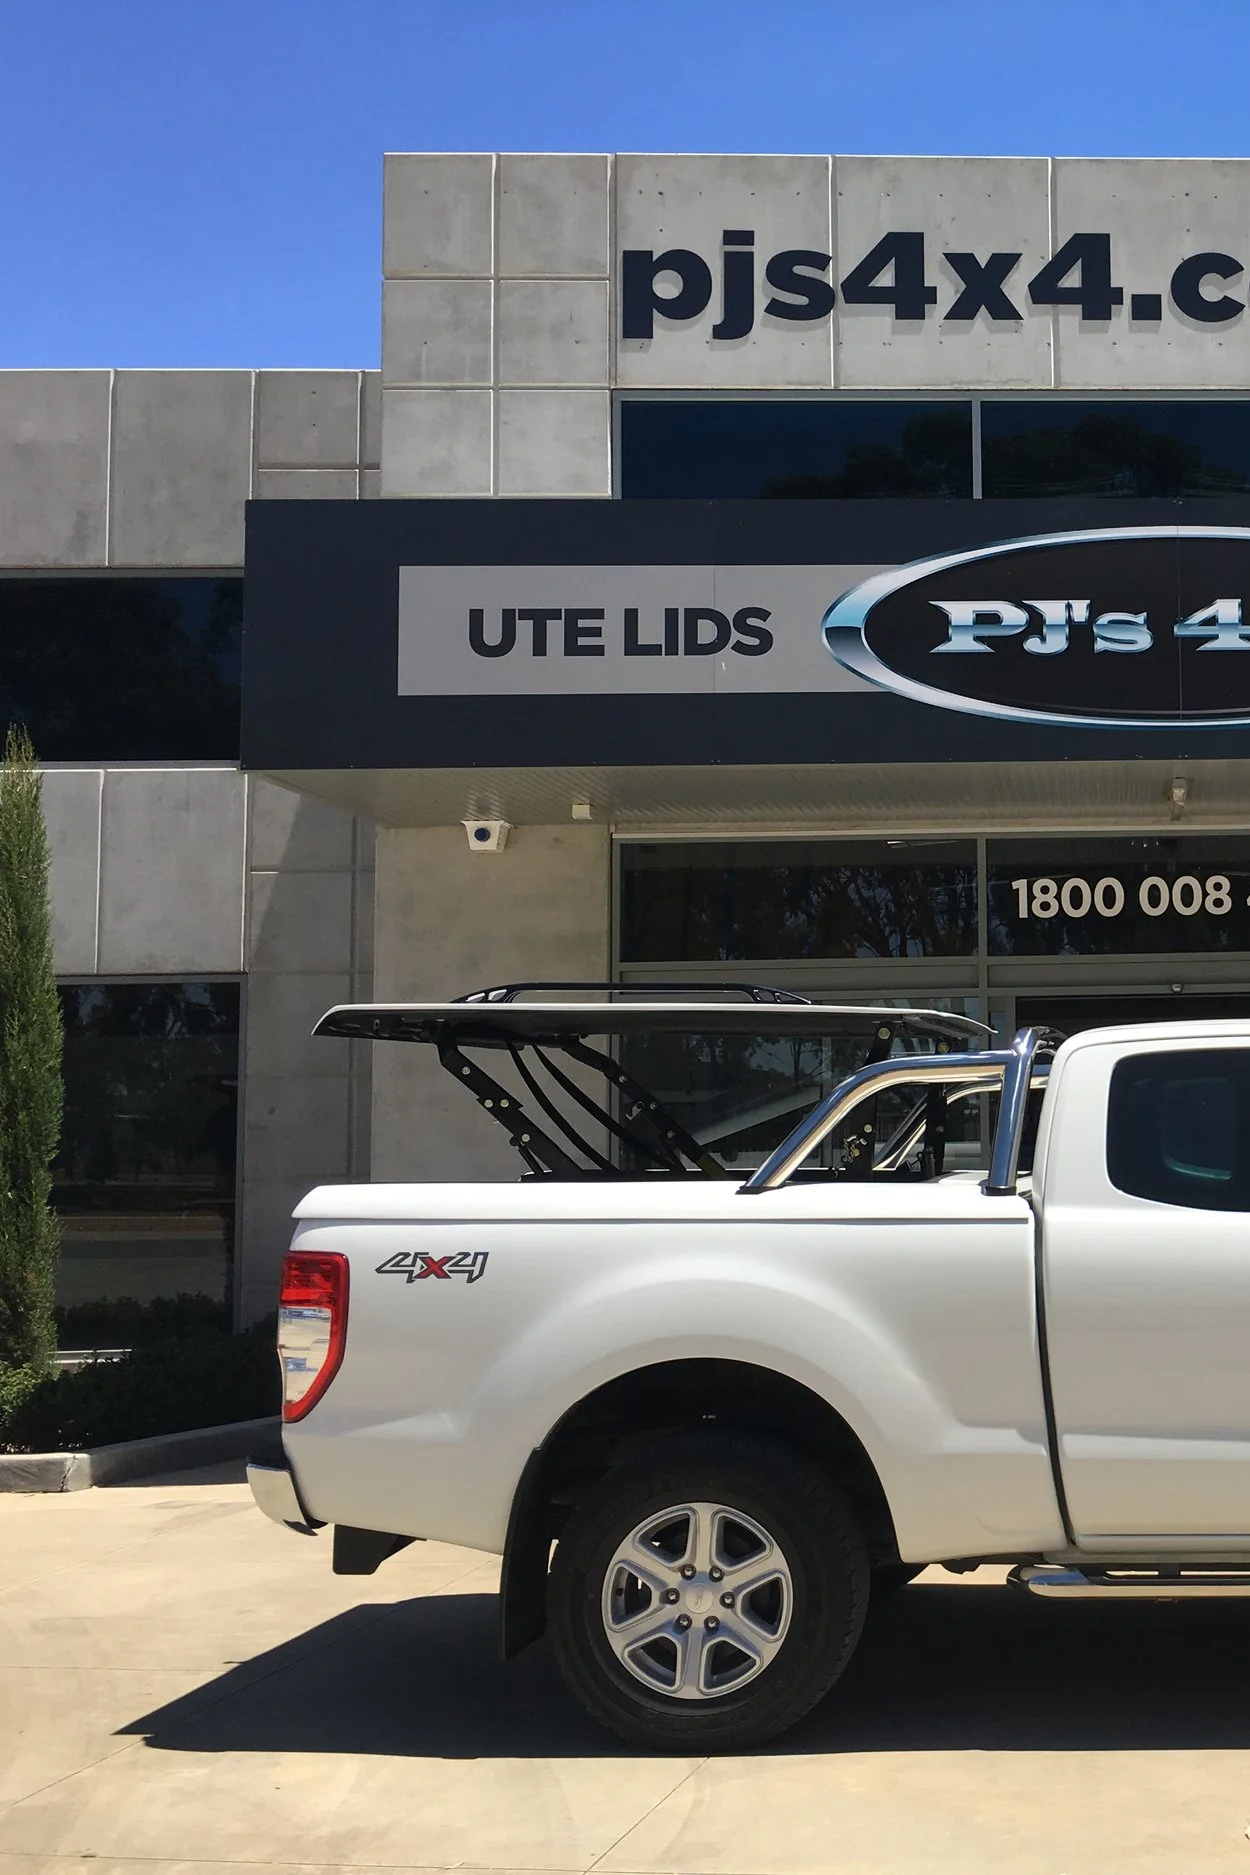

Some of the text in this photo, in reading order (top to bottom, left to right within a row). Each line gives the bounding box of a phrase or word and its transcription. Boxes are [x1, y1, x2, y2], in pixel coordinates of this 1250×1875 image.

[468, 606, 774, 658] UTE LIDS
[928, 599, 1155, 656] PJ's
[1011, 877, 1125, 919] 1800
[1138, 875, 1232, 917] 008
